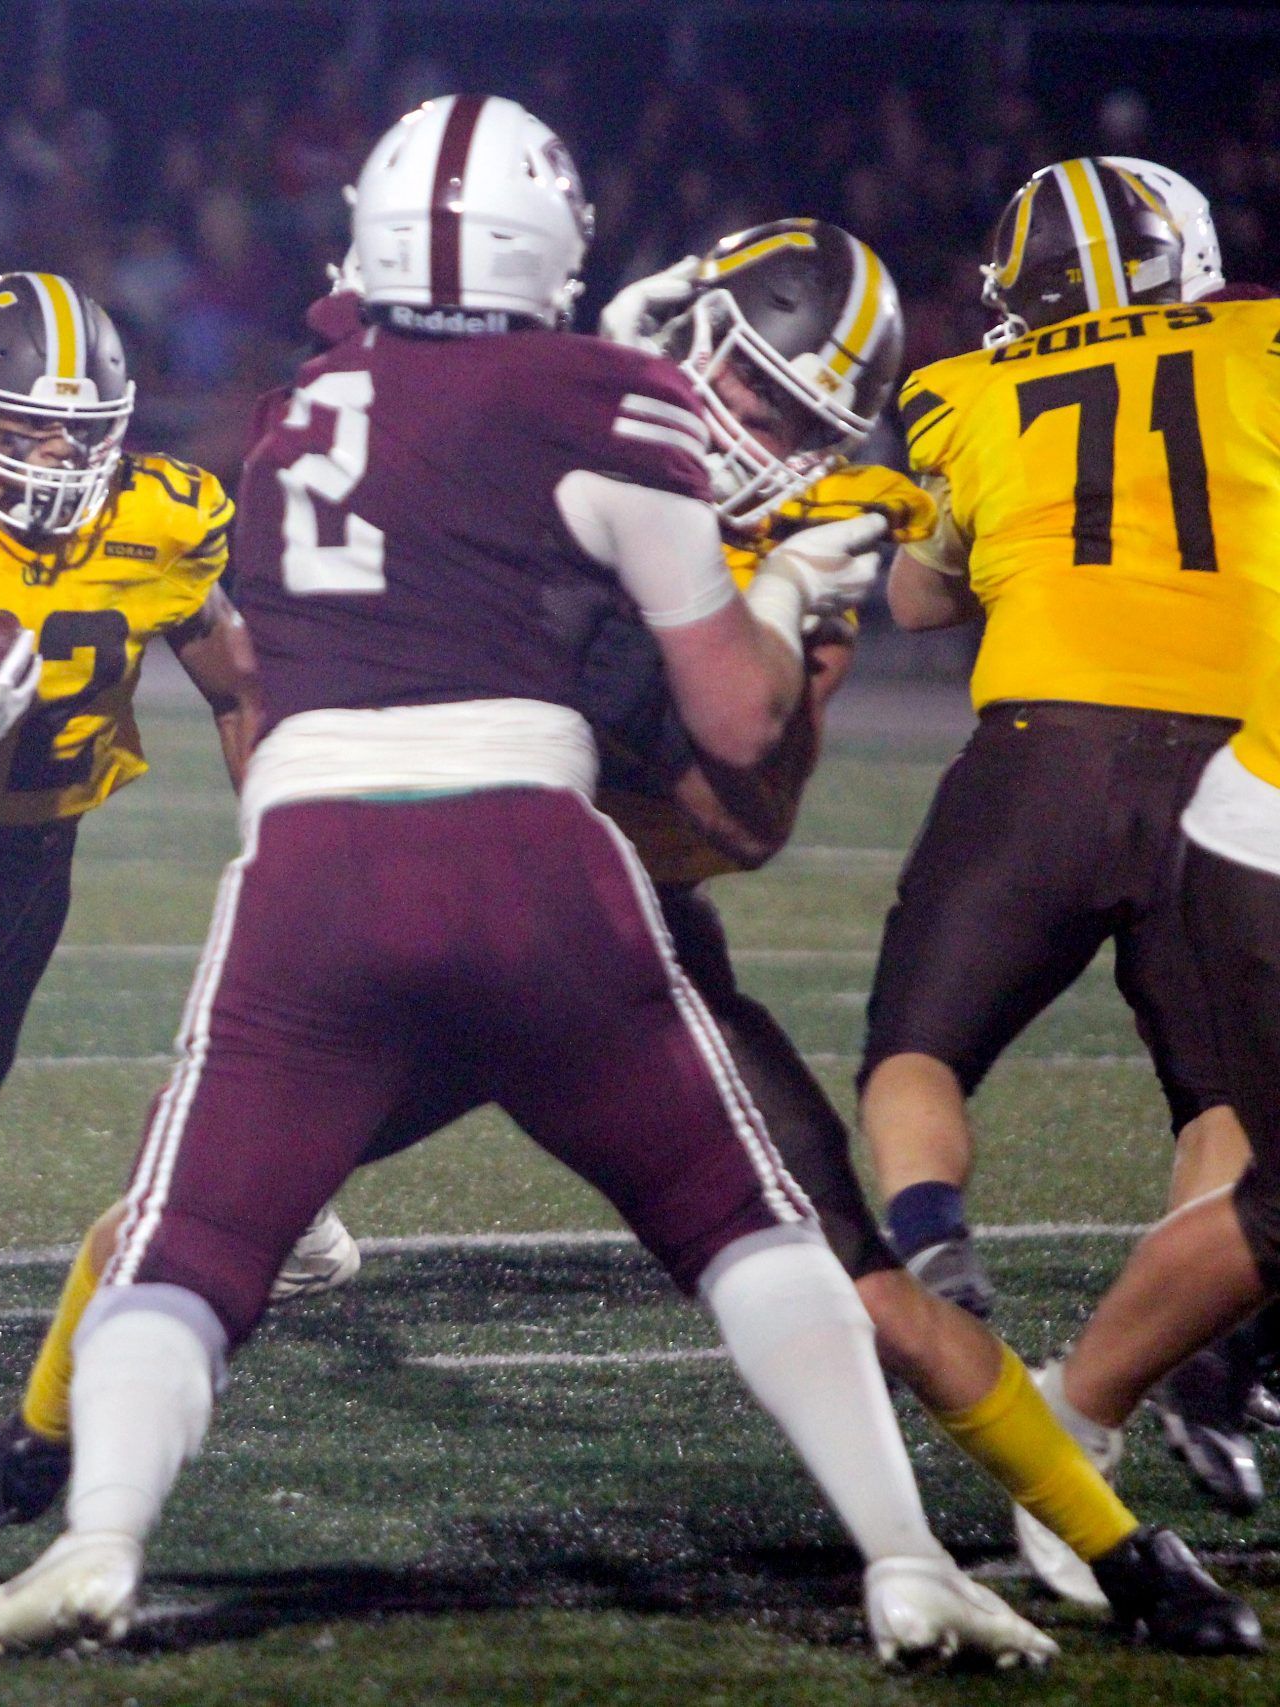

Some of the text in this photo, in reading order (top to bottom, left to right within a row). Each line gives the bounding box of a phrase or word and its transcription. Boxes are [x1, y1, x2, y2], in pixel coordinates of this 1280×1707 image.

[392, 305, 508, 333] Riddell
[990, 306, 1214, 365] COLTS
[277, 370, 387, 594] 2
[1015, 349, 1219, 573] 71
